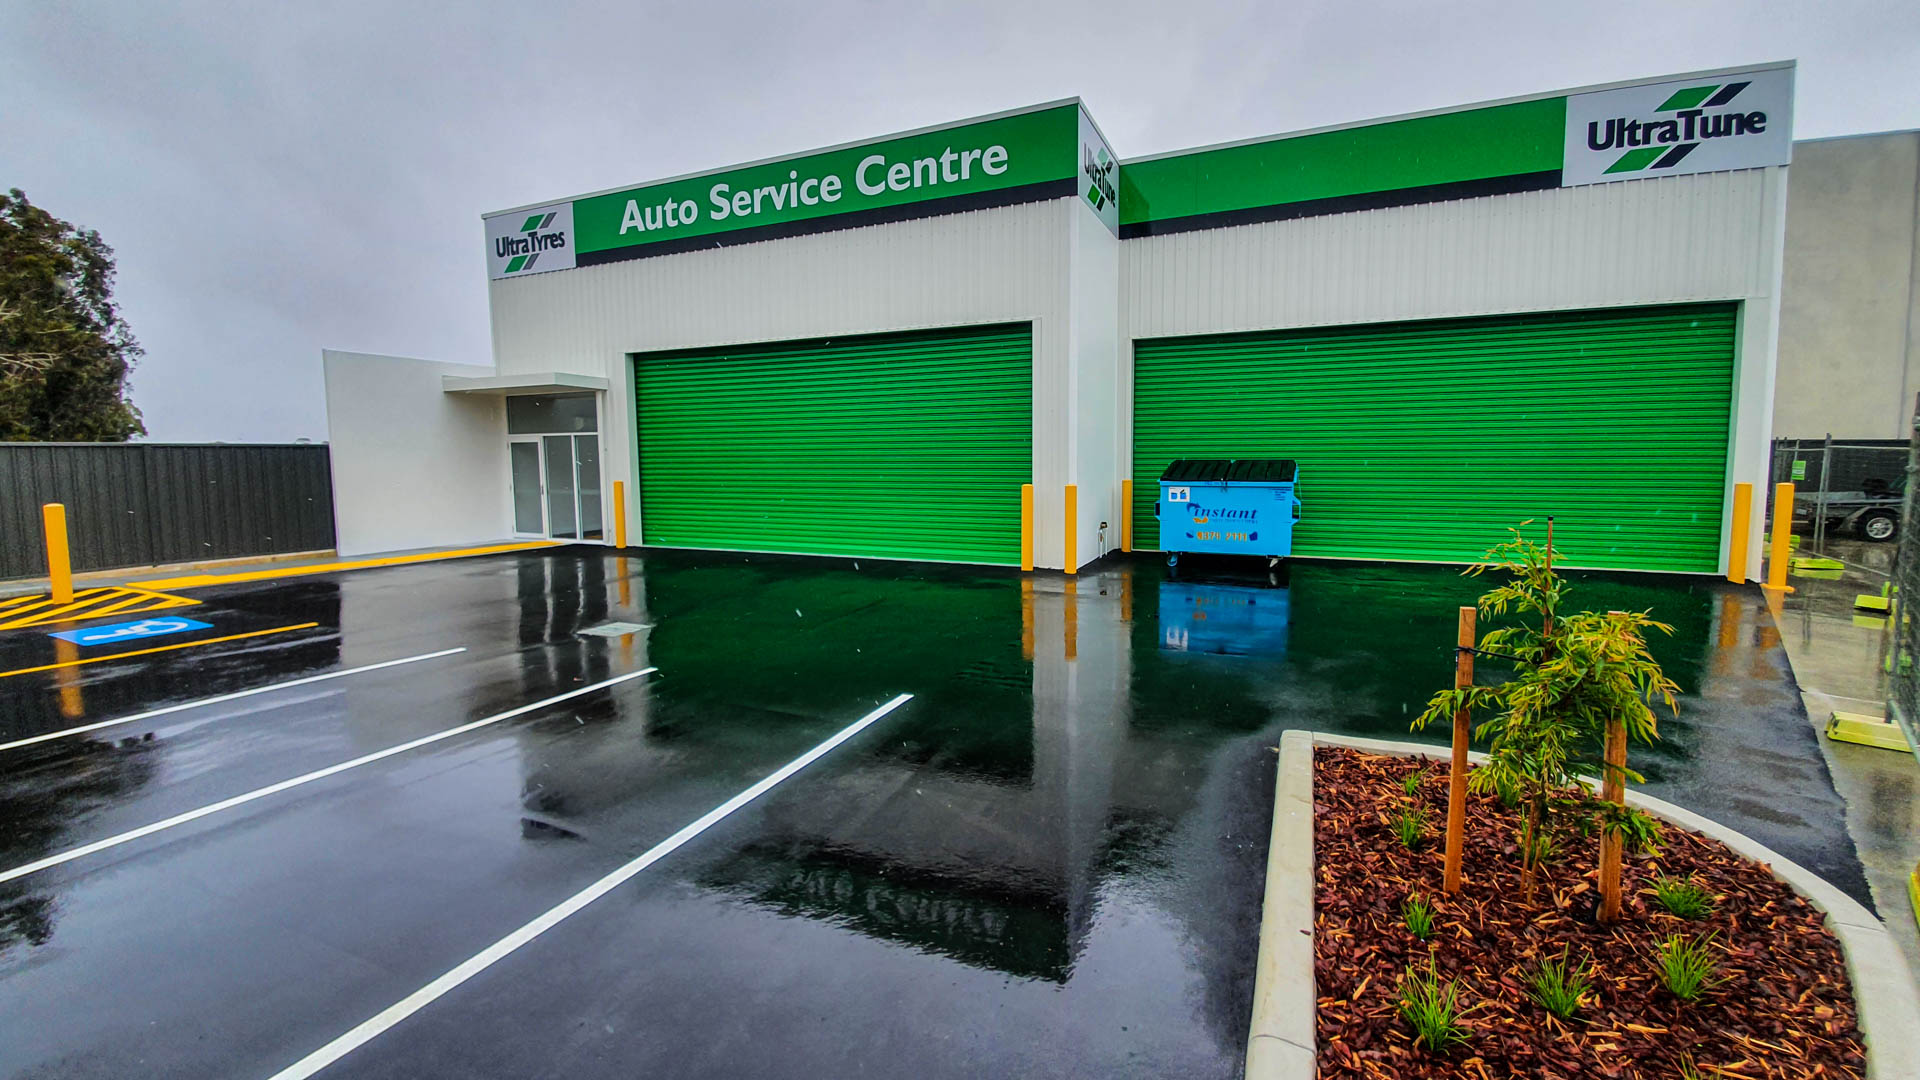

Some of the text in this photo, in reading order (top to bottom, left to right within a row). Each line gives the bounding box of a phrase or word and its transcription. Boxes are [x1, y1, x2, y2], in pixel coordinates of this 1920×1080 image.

[619, 144, 1008, 235] Auto Service Centre
